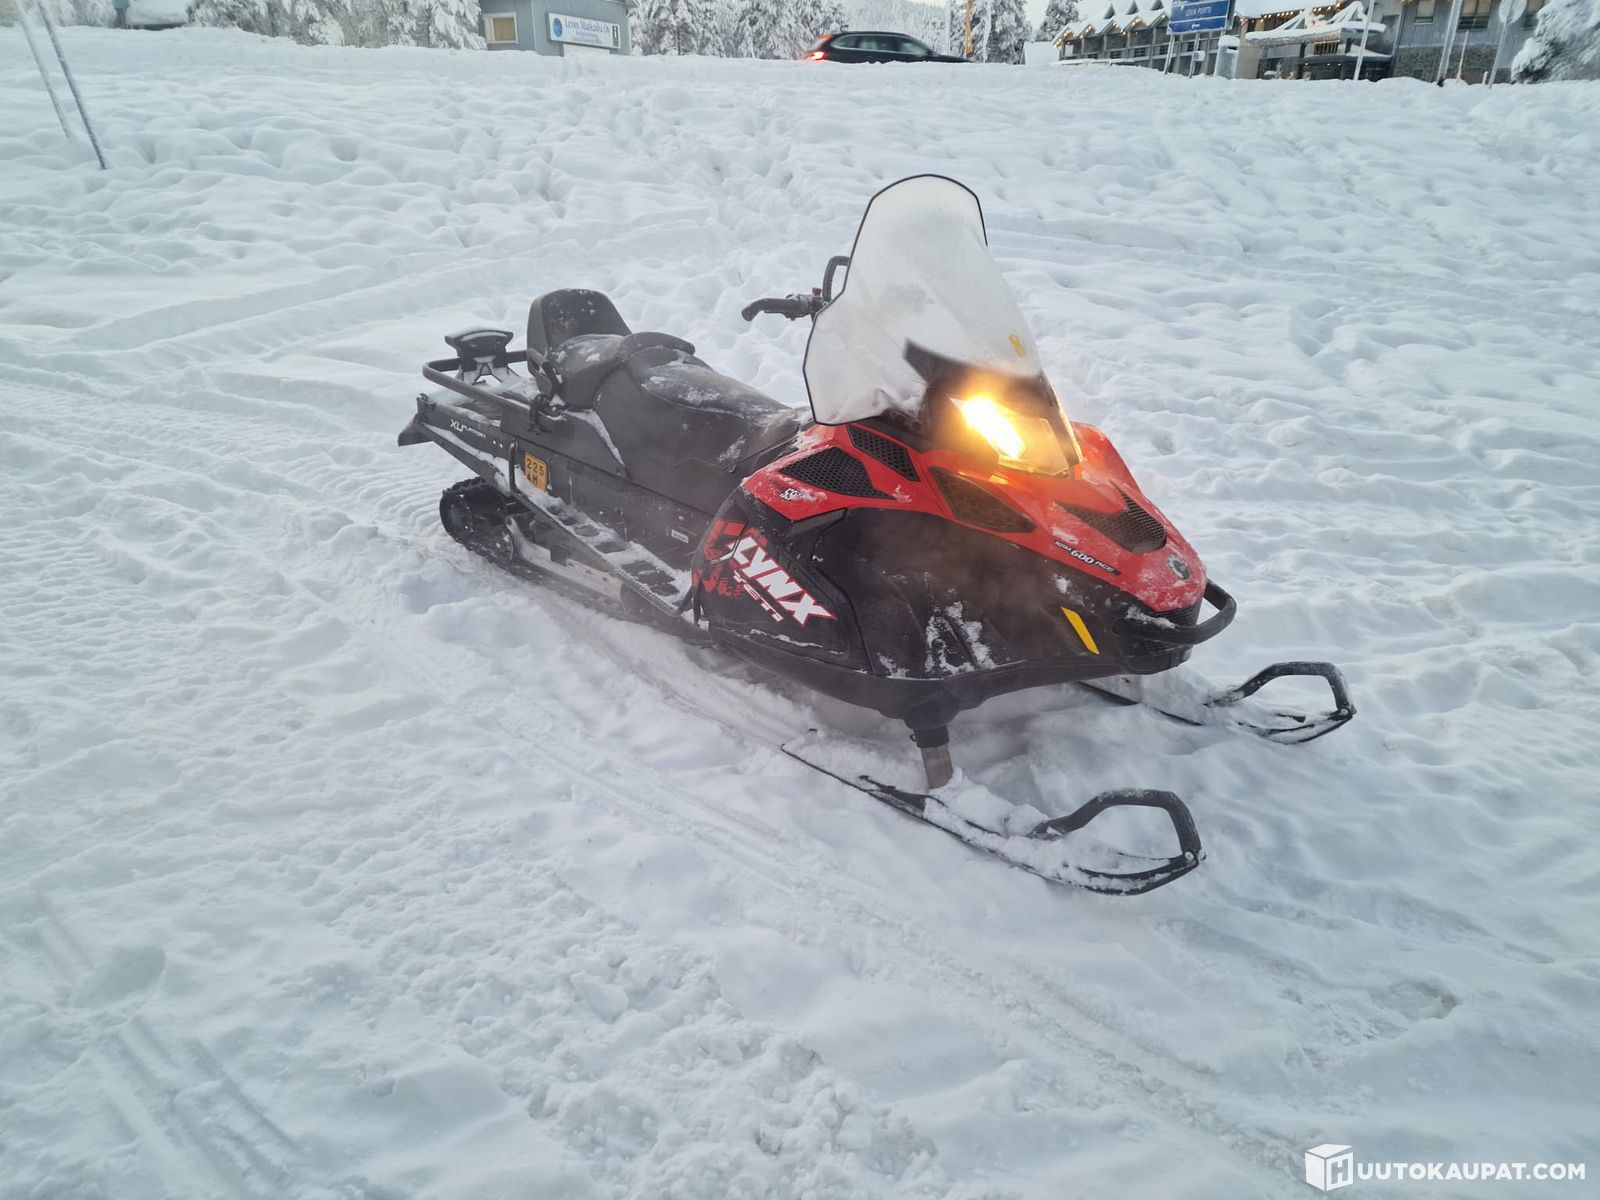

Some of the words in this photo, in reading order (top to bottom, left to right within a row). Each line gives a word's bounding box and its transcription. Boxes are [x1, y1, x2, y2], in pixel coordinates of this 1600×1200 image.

[526, 458, 544, 477] 225
[1055, 541, 1073, 552] ROTAX
[1071, 550, 1095, 564] 600
[724, 535, 837, 627] LYNX
[733, 569, 784, 622] YETI
